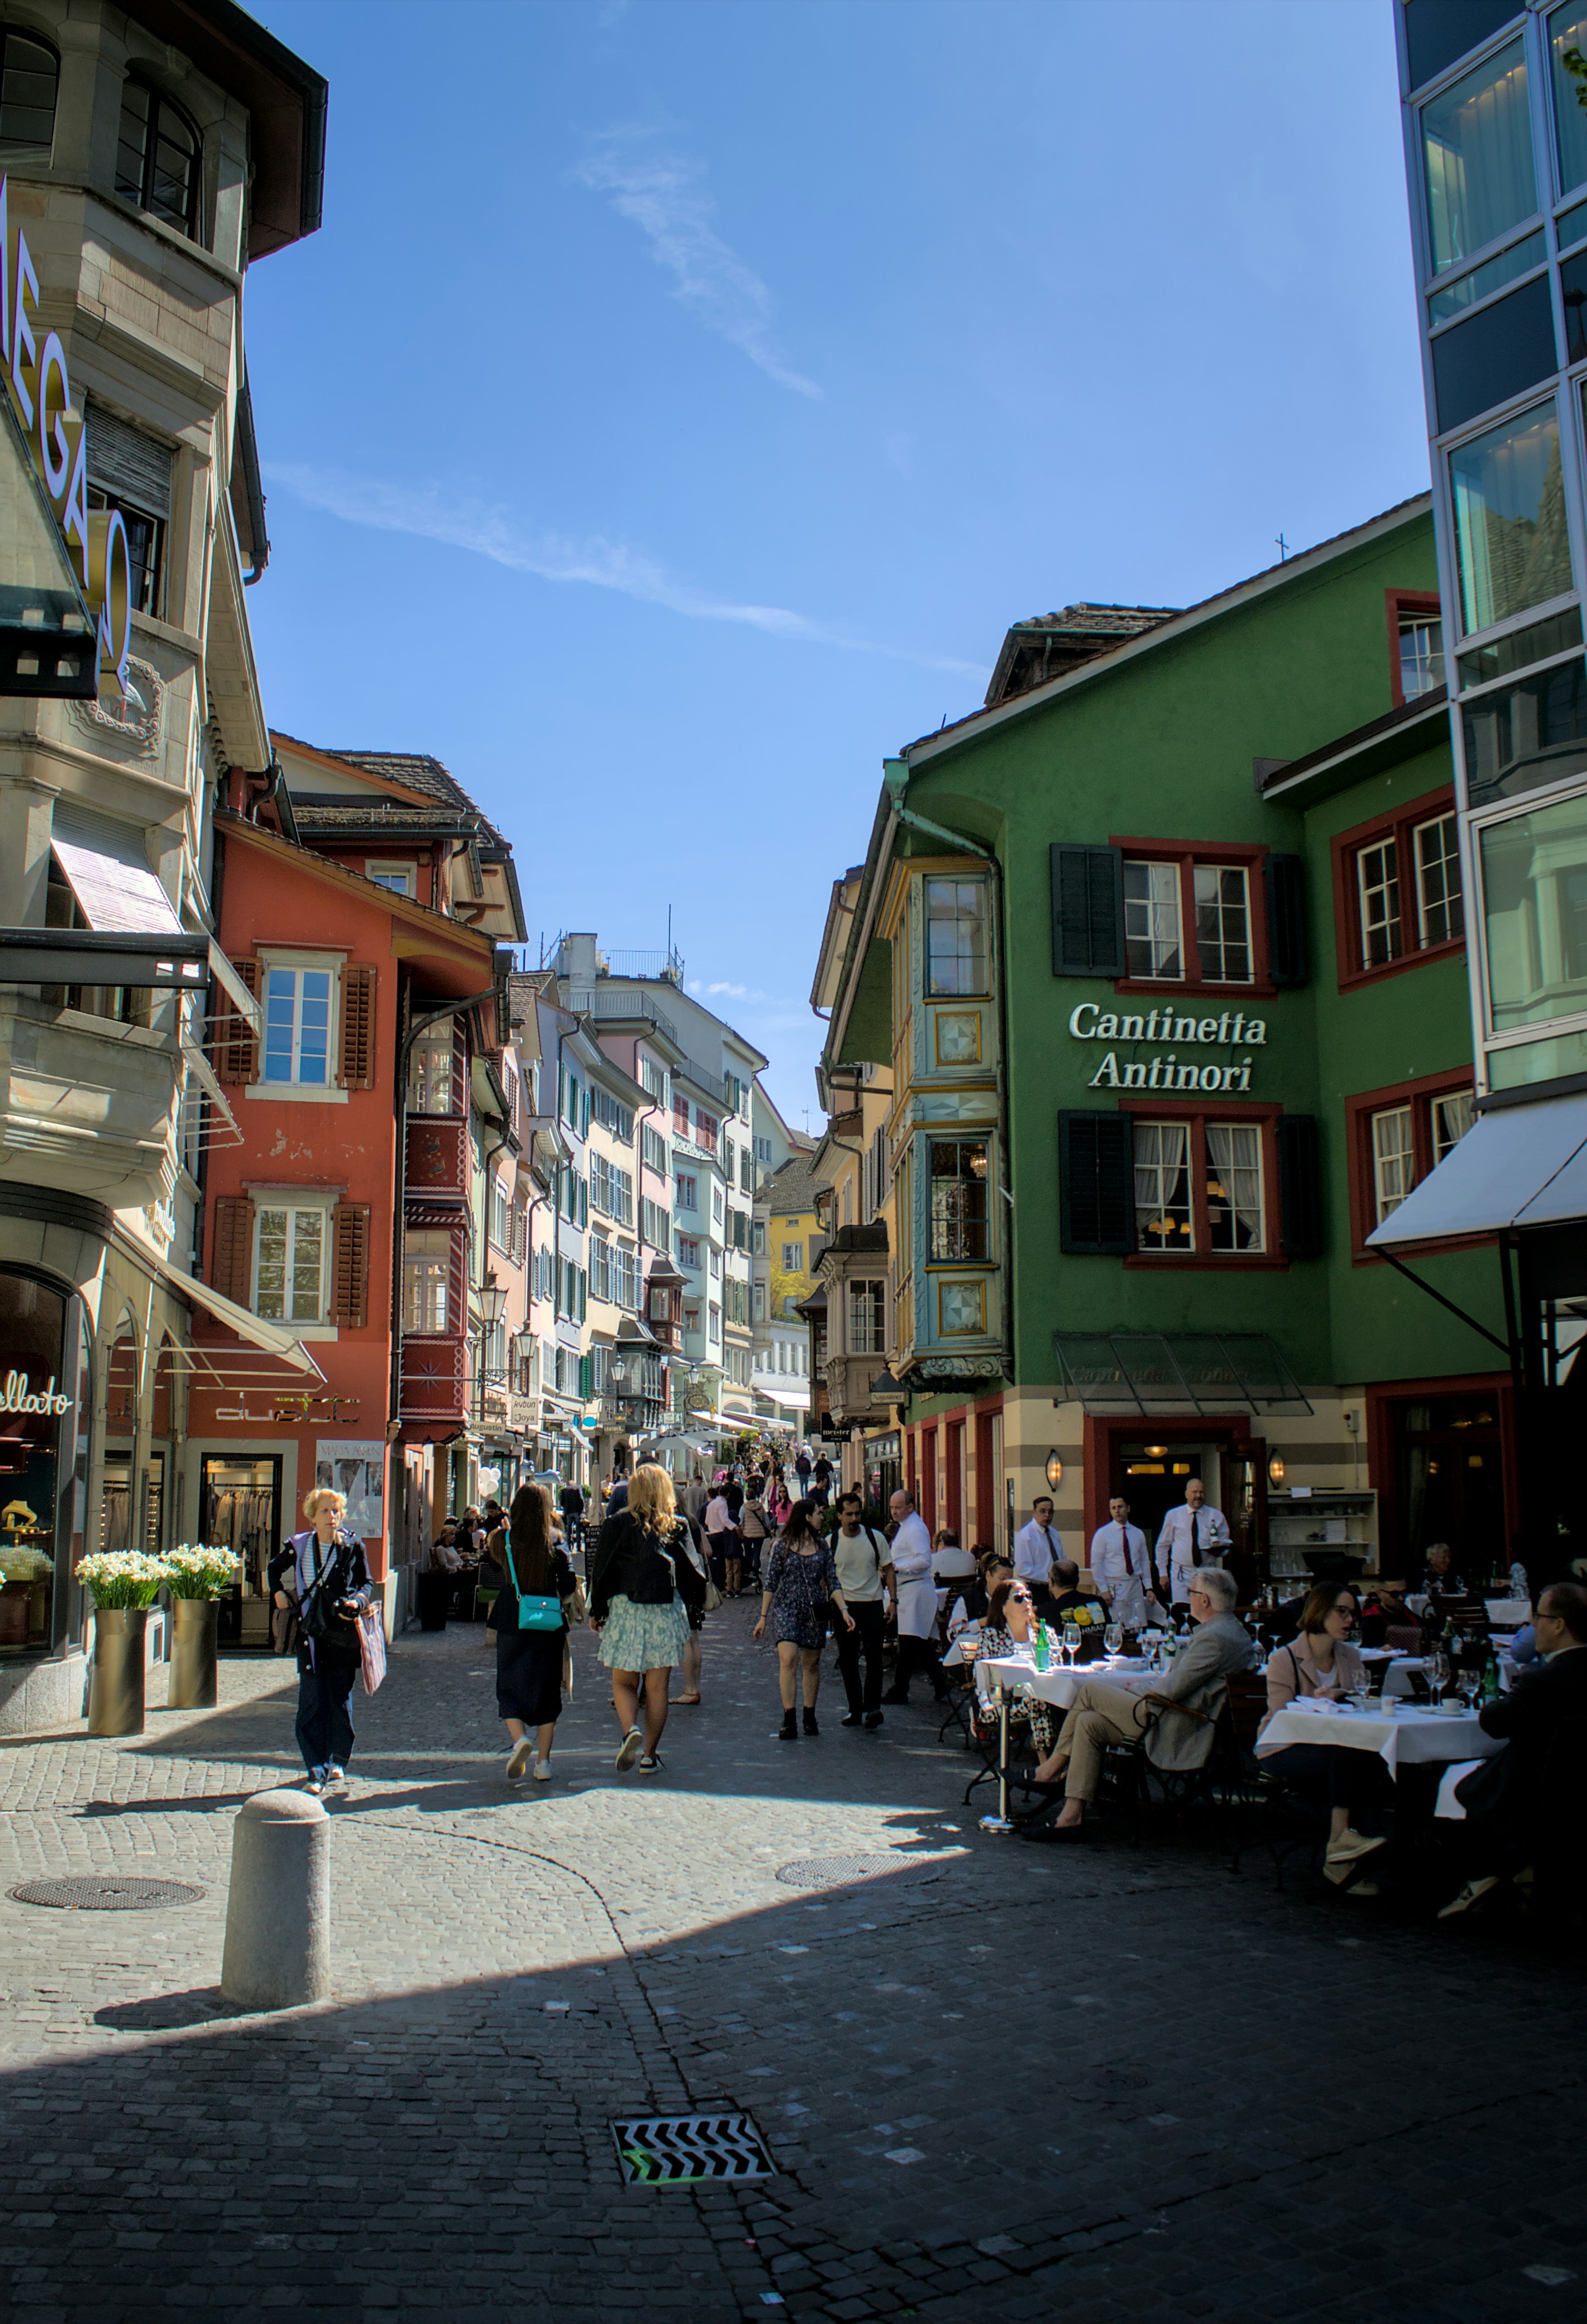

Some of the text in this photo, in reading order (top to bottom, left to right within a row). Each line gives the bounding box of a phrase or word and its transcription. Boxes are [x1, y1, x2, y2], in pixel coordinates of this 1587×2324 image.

[1069, 1003, 1267, 1045] Cantinetta
[1087, 1052, 1253, 1091] Antinori
[514, 1400, 536, 1408] kybun
